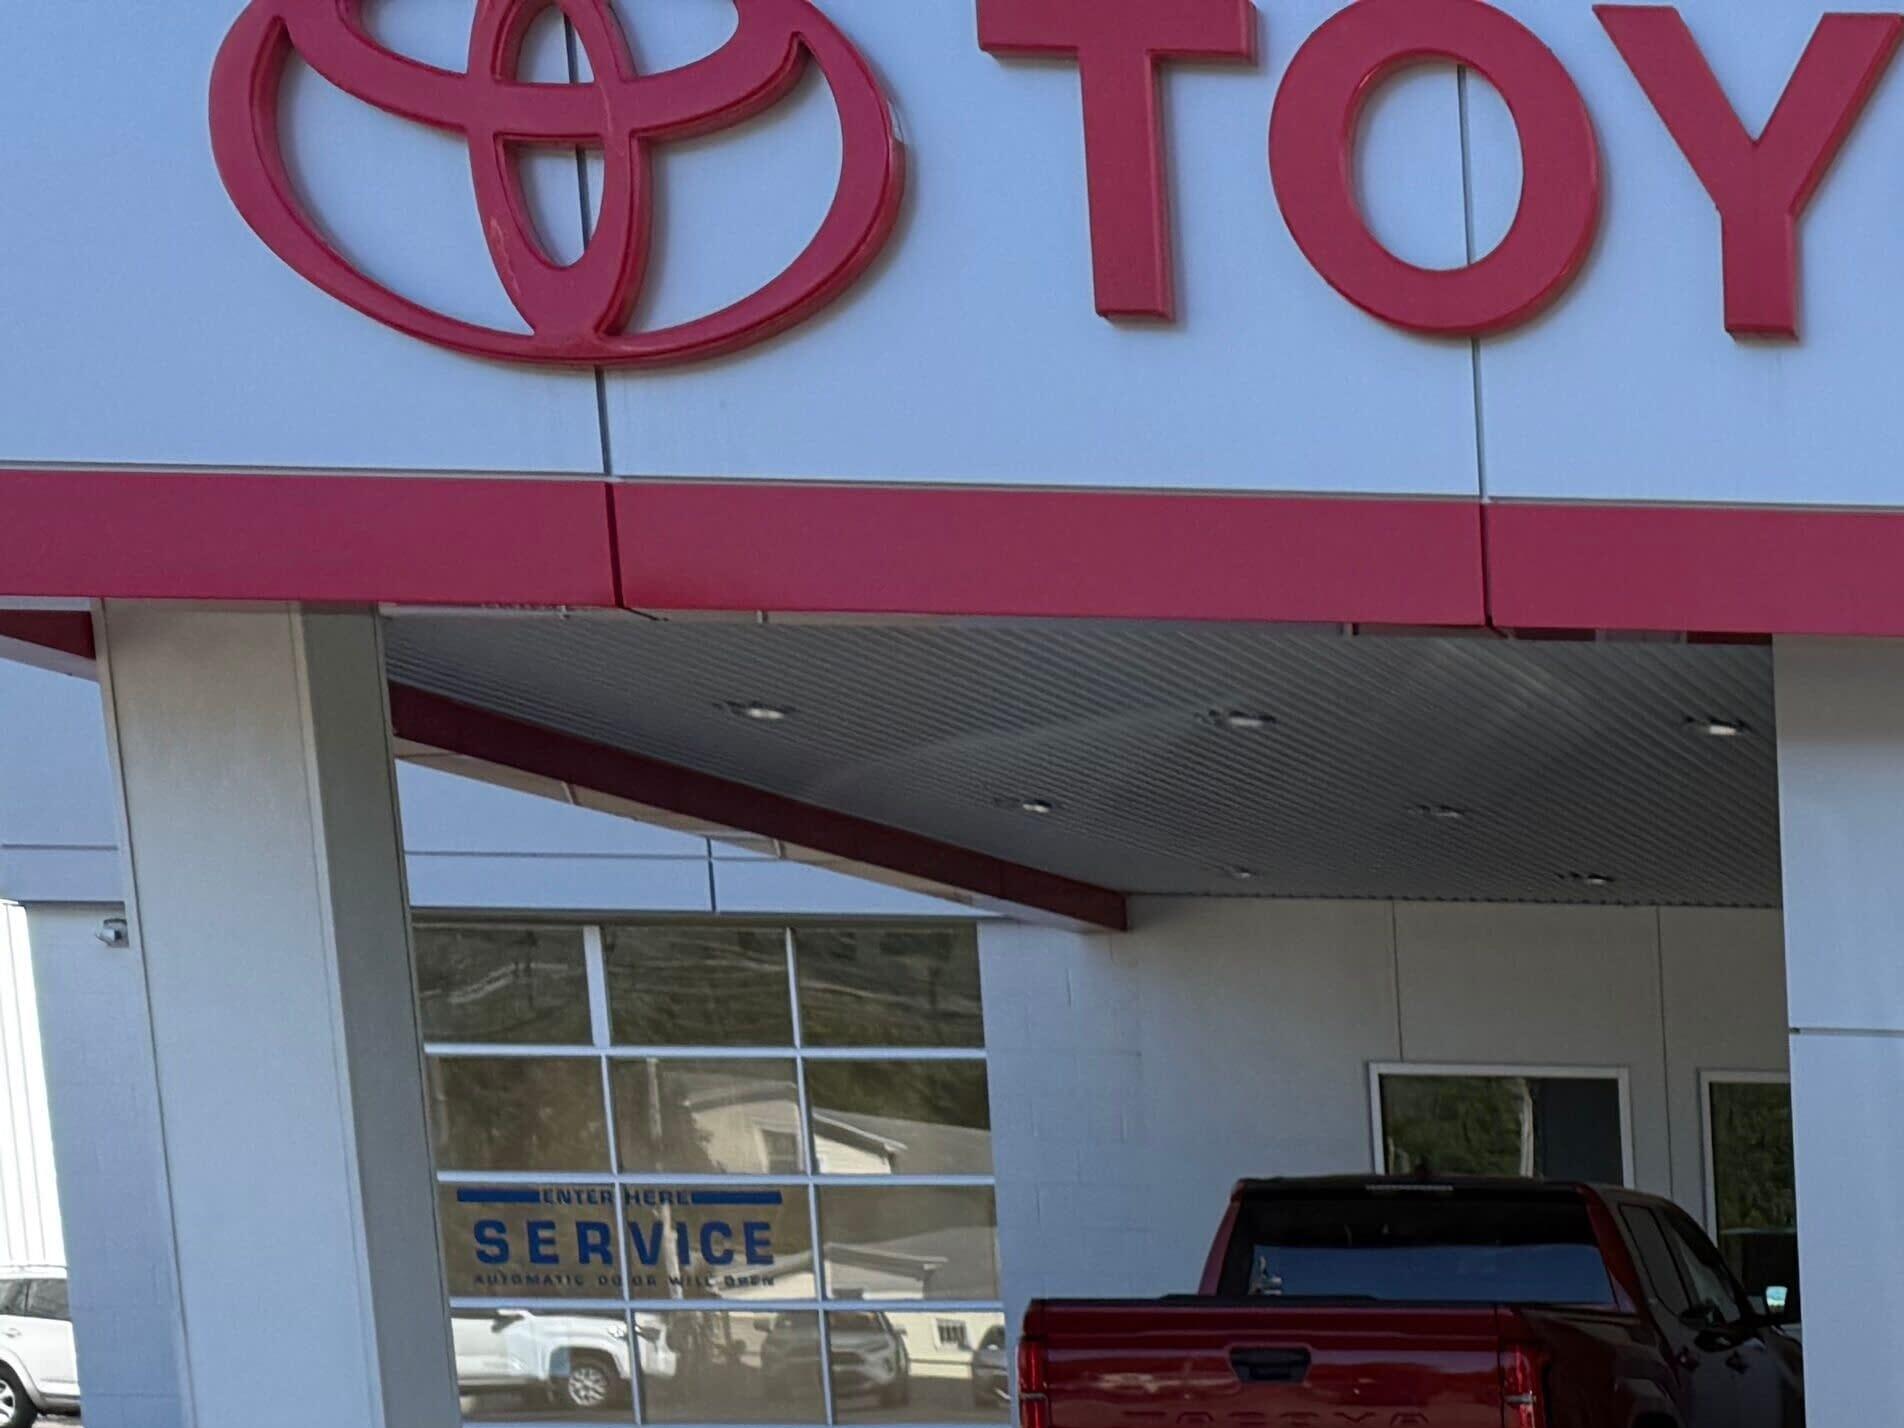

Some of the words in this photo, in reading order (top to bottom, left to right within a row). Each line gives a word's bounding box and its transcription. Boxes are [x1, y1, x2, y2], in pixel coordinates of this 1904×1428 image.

[542, 1189, 614, 1204] ENTER
[623, 1189, 690, 1205] HERE
[473, 1219, 775, 1265] SERVICE
[474, 1273, 583, 1286] AUTOMATIC
